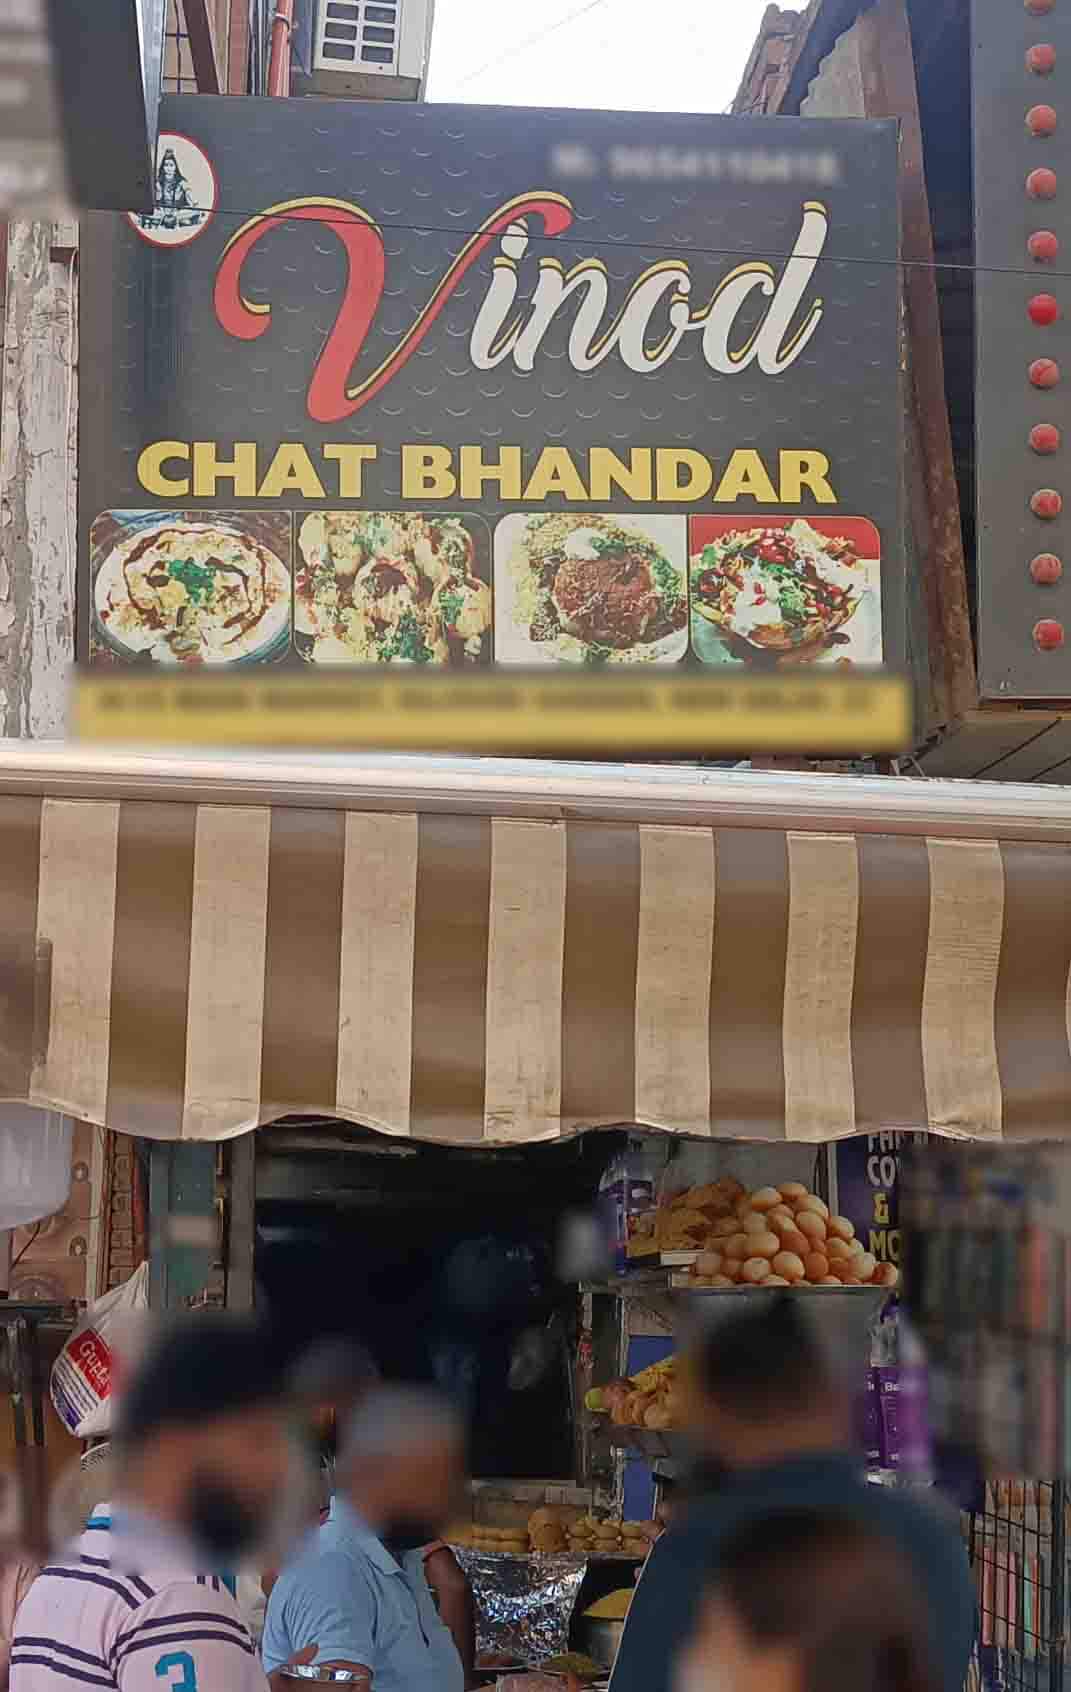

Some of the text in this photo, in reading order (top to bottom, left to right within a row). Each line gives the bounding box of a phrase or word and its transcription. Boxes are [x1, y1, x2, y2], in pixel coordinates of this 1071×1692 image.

[214, 191, 828, 423] Vinod
[136, 440, 838, 505] CHAT BHANDAR
